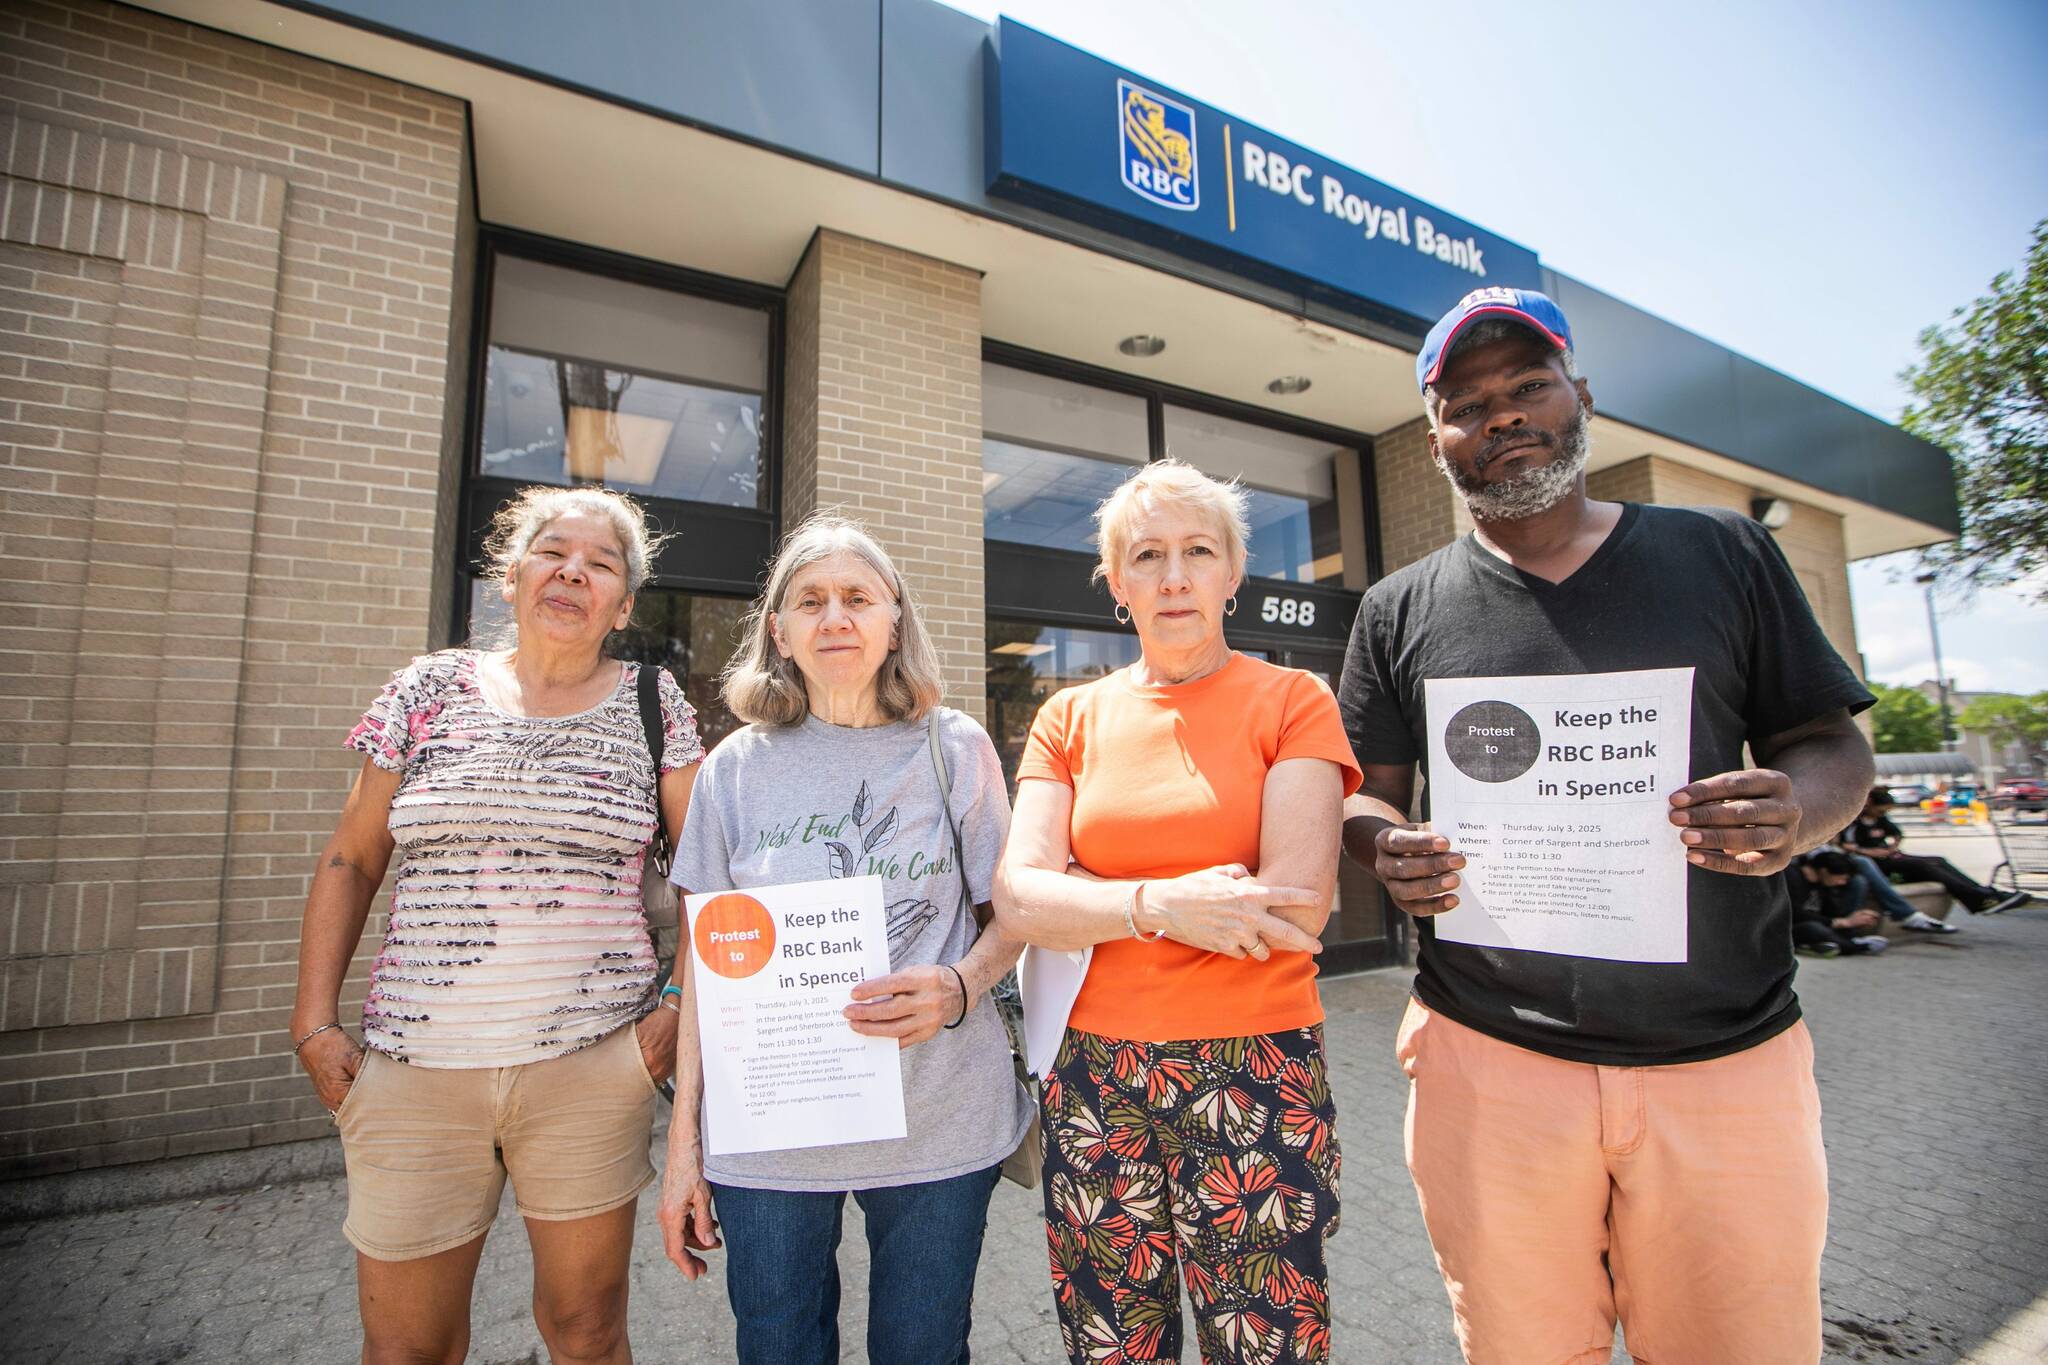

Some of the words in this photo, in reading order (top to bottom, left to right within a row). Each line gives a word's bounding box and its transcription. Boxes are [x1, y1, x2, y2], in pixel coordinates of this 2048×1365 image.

[1131, 159, 1191, 203] RBC
[1242, 140, 1316, 206] RBC
[1321, 175, 1411, 247] Royal
[1414, 215, 1487, 278] Bank
[1261, 596, 1316, 627] 588
[1555, 710, 1612, 730] Keep
[1619, 705, 1658, 725] the
[1468, 725, 1515, 737] Protest
[1485, 744, 1498, 755] to
[1548, 745, 1594, 762] RBC
[1601, 740, 1657, 761] Bank
[1538, 779, 1558, 796] in
[1566, 775, 1655, 800] Spence!
[754, 816, 801, 855] West
[802, 813, 851, 844] End
[1458, 822, 1487, 831] When:
[1502, 824, 1544, 833] Thursday,
[1547, 824, 1564, 834] July
[1567, 824, 1576, 833] 3,
[1578, 824, 1601, 833] 2025
[1459, 837, 1491, 845] Where:
[1502, 837, 1532, 846] Corner
[1534, 838, 1544, 846] of
[1547, 838, 1581, 849] Sargent
[1583, 839, 1601, 848] and
[1603, 837, 1650, 848] Sherbrook
[1459, 850, 1483, 858] Time:
[1503, 851, 1527, 860] 11:30
[1530, 852, 1539, 860] to
[1542, 852, 1562, 860] 1:30
[867, 853, 900, 880] We
[907, 846, 954, 881] Care!
[1502, 864, 1515, 872] the
[1517, 864, 1543, 872] Petition
[1567, 866, 1597, 875] Minister
[1608, 868, 1636, 876] Finance
[1637, 868, 1645, 876] of
[1564, 875, 1601, 884] signatures
[1528, 890, 1547, 898] Press
[1548, 892, 1587, 901] Conference
[1586, 886, 1612, 894] picture
[1550, 900, 1573, 908] invited
[784, 912, 826, 929] Keep
[831, 907, 860, 923] the
[1580, 911, 1601, 919] listen
[710, 928, 761, 943] Protest
[782, 942, 816, 959] RBC
[821, 936, 863, 955] Bank
[729, 951, 744, 962] to
[779, 974, 794, 989] in
[799, 967, 865, 987] Spence!
[788, 999, 802, 1009] July
[811, 996, 829, 1005] 2025
[765, 1014, 776, 1023] the
[777, 1012, 803, 1023] parking
[804, 1010, 815, 1019] lot
[815, 1010, 830, 1018] near
[757, 1026, 784, 1036] Sargent
[785, 1024, 798, 1033] and
[799, 1021, 834, 1031] Sherbrook
[758, 1041, 775, 1049] from
[807, 1036, 822, 1044] 1:30
